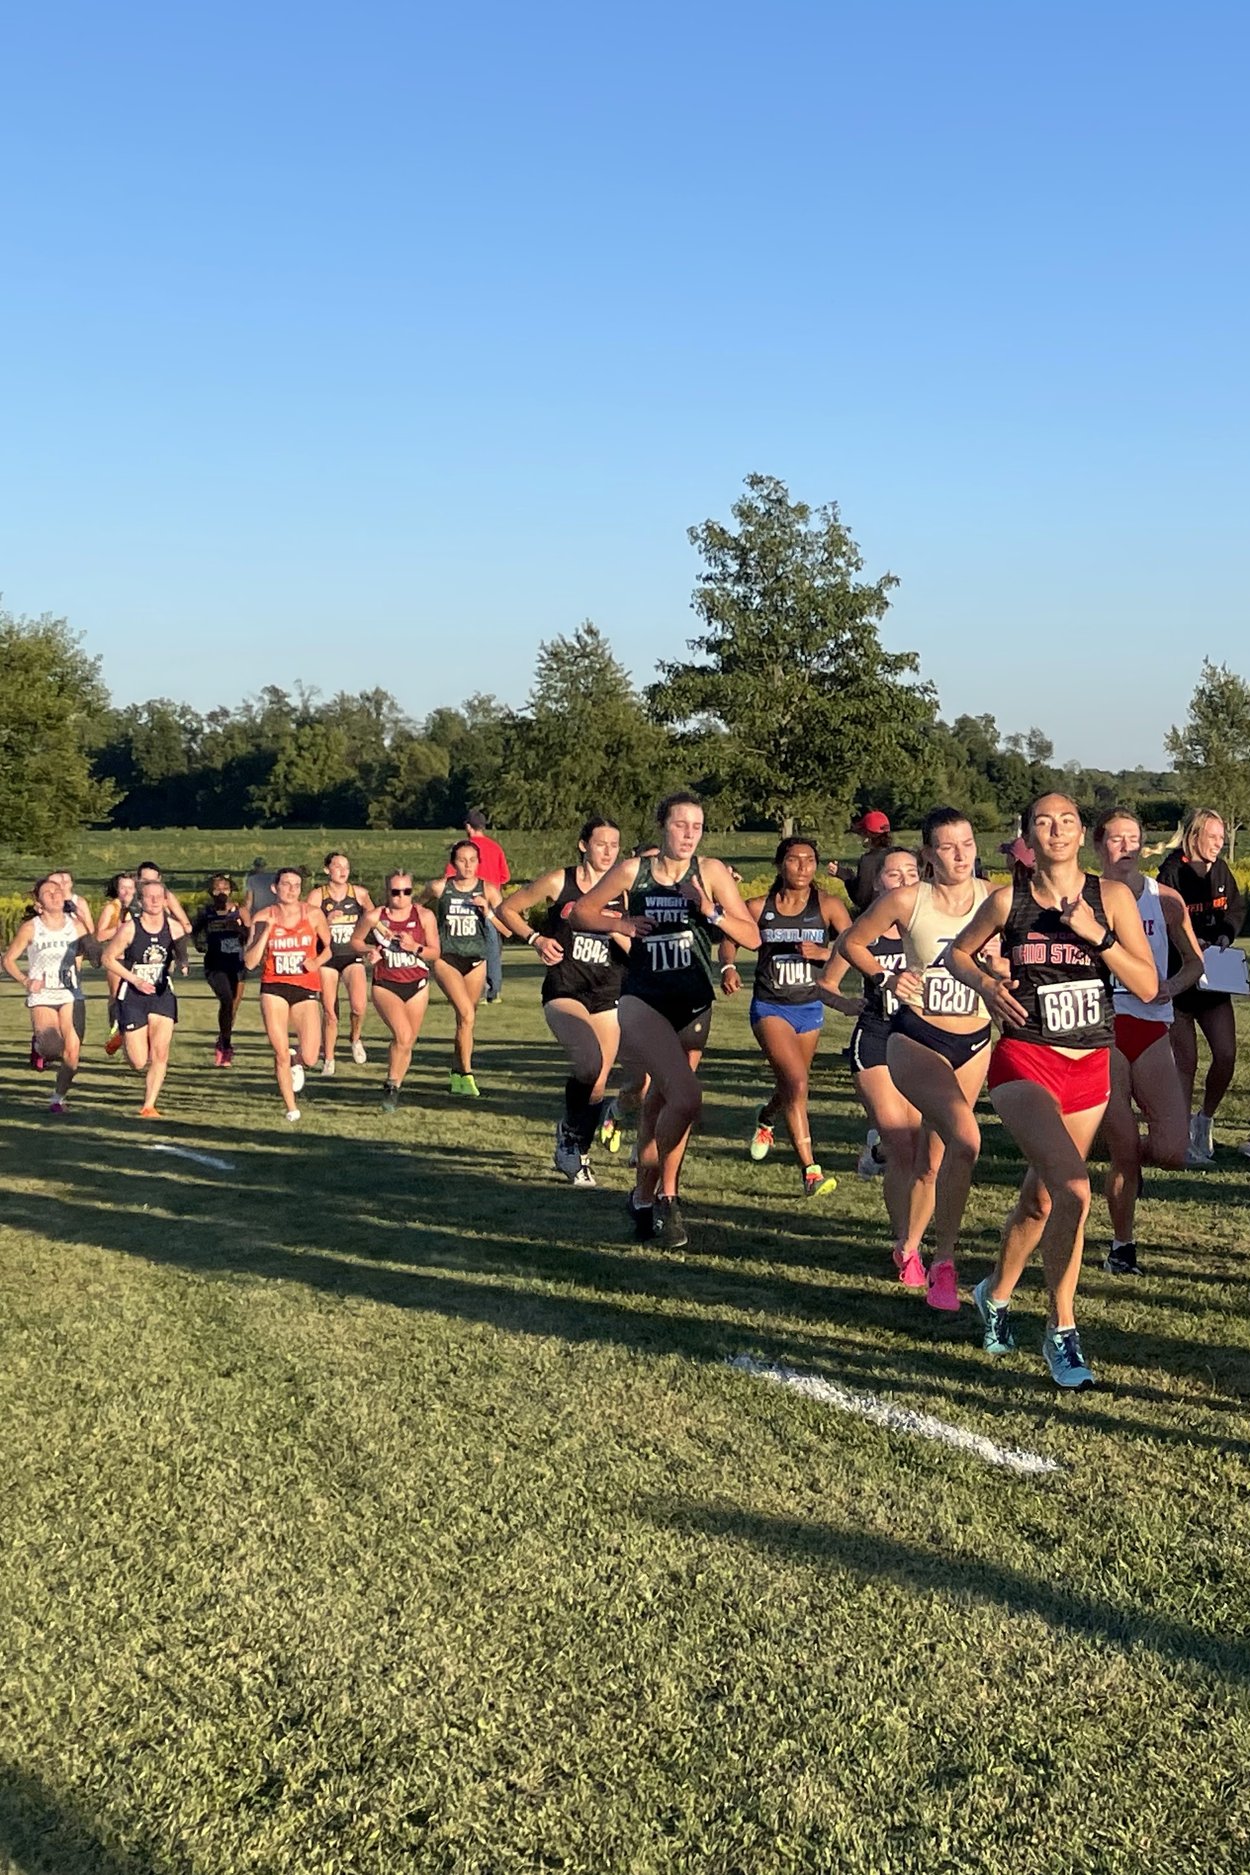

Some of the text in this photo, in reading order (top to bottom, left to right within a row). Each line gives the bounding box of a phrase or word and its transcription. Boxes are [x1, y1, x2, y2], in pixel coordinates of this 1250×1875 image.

[644, 896, 688, 907] WRIGHT
[761, 928, 825, 944] RSULINE
[1013, 943, 1047, 966] OHIO
[929, 977, 976, 1011] 6287
[1044, 987, 1101, 1032] 6815
